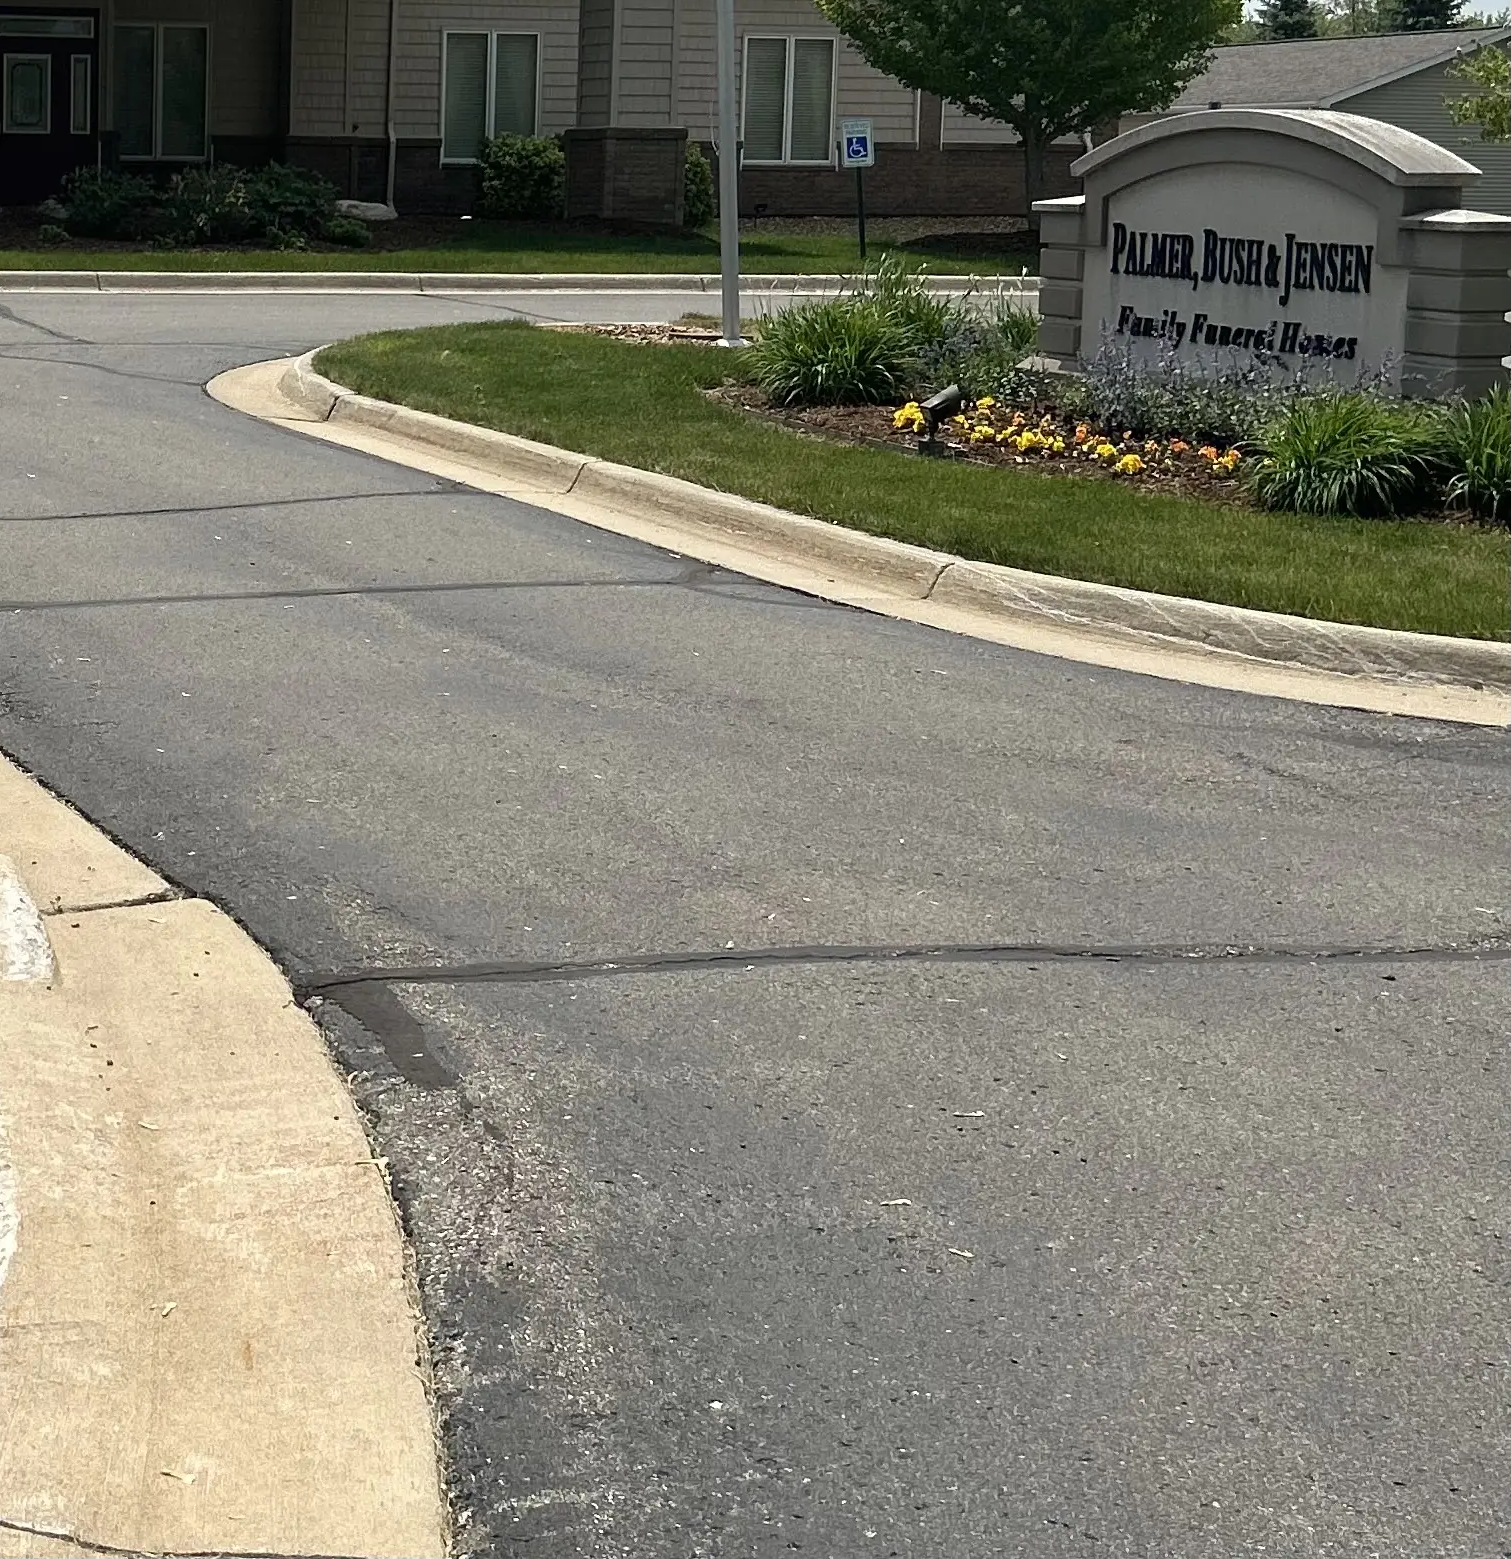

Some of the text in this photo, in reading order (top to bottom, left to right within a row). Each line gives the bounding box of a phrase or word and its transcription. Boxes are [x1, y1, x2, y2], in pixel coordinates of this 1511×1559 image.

[1201, 228, 1265, 287] BUSH
[1264, 243, 1282, 288] &
[1279, 233, 1374, 306] JENSEN
